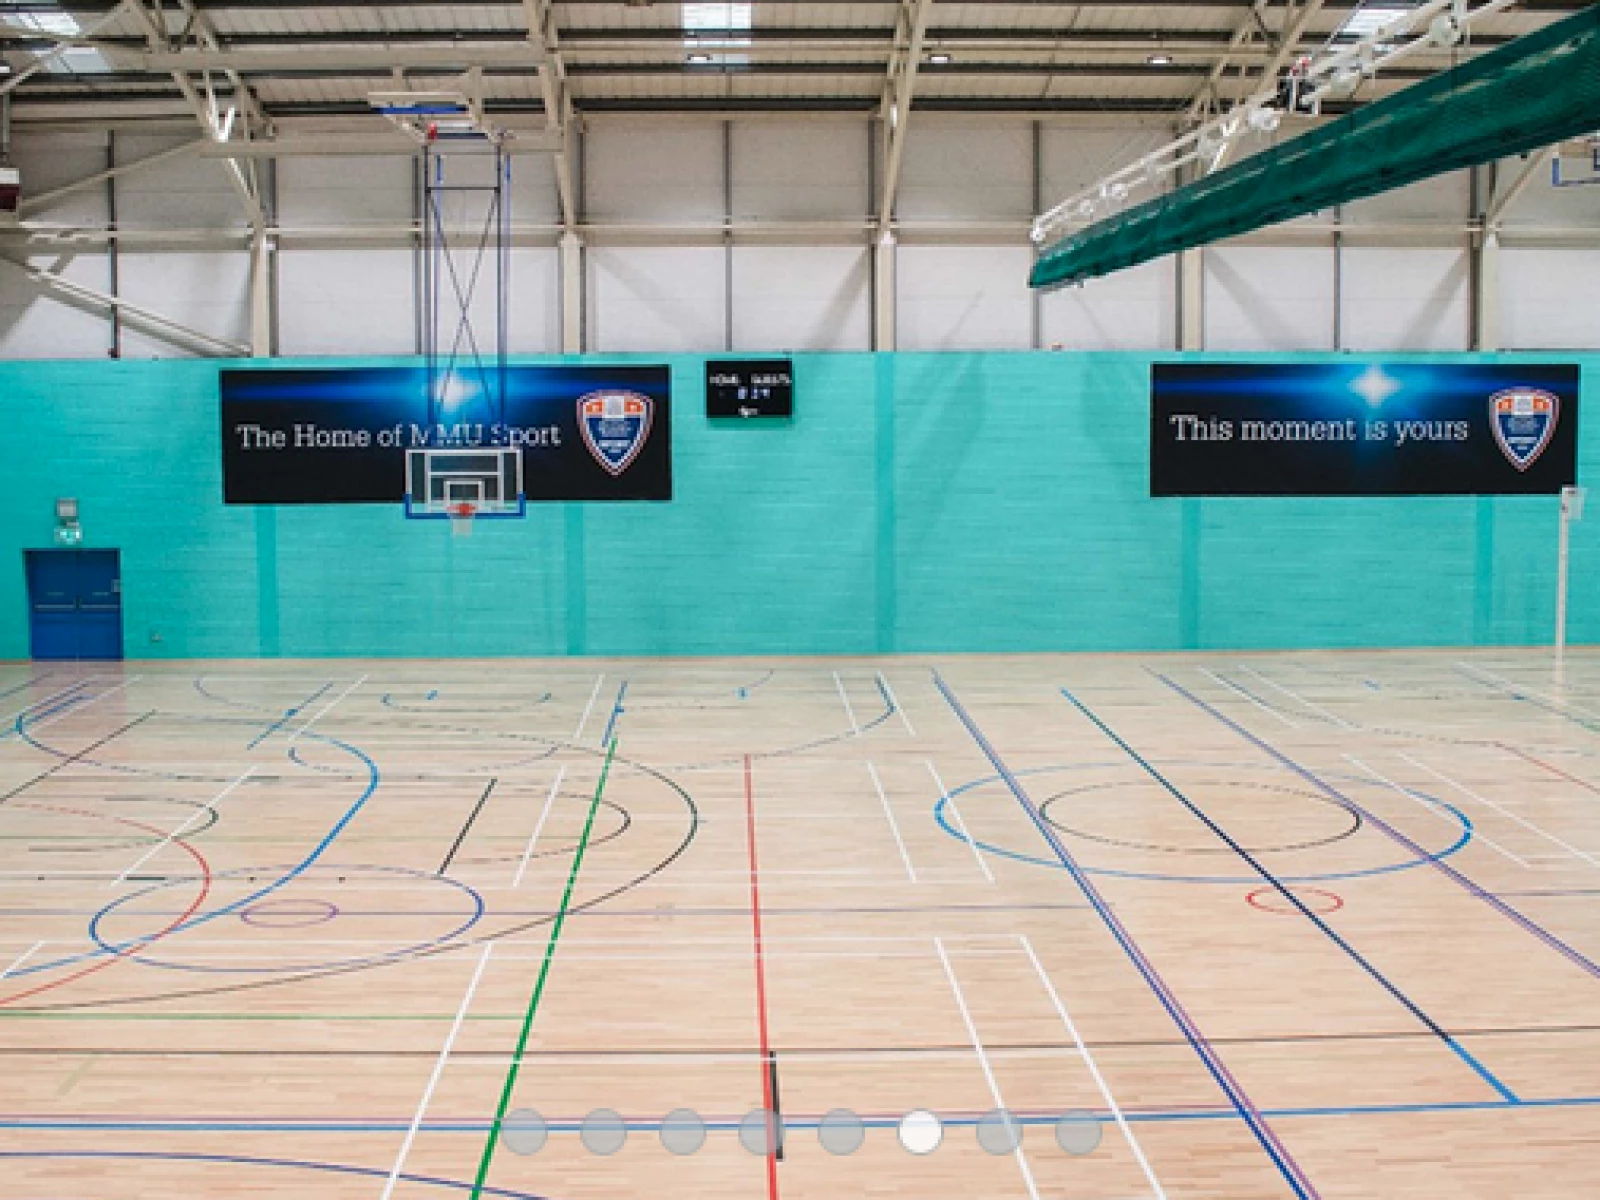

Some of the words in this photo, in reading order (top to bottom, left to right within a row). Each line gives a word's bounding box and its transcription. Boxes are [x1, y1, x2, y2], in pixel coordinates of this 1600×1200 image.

[235, 423, 286, 449] The
[294, 423, 371, 448] Home
[376, 423, 403, 447] of
[490, 423, 562, 450] Sport
[1170, 415, 1233, 441] This
[1241, 418, 1357, 441] moment
[1364, 415, 1388, 441] is
[1393, 420, 1469, 447] yours
